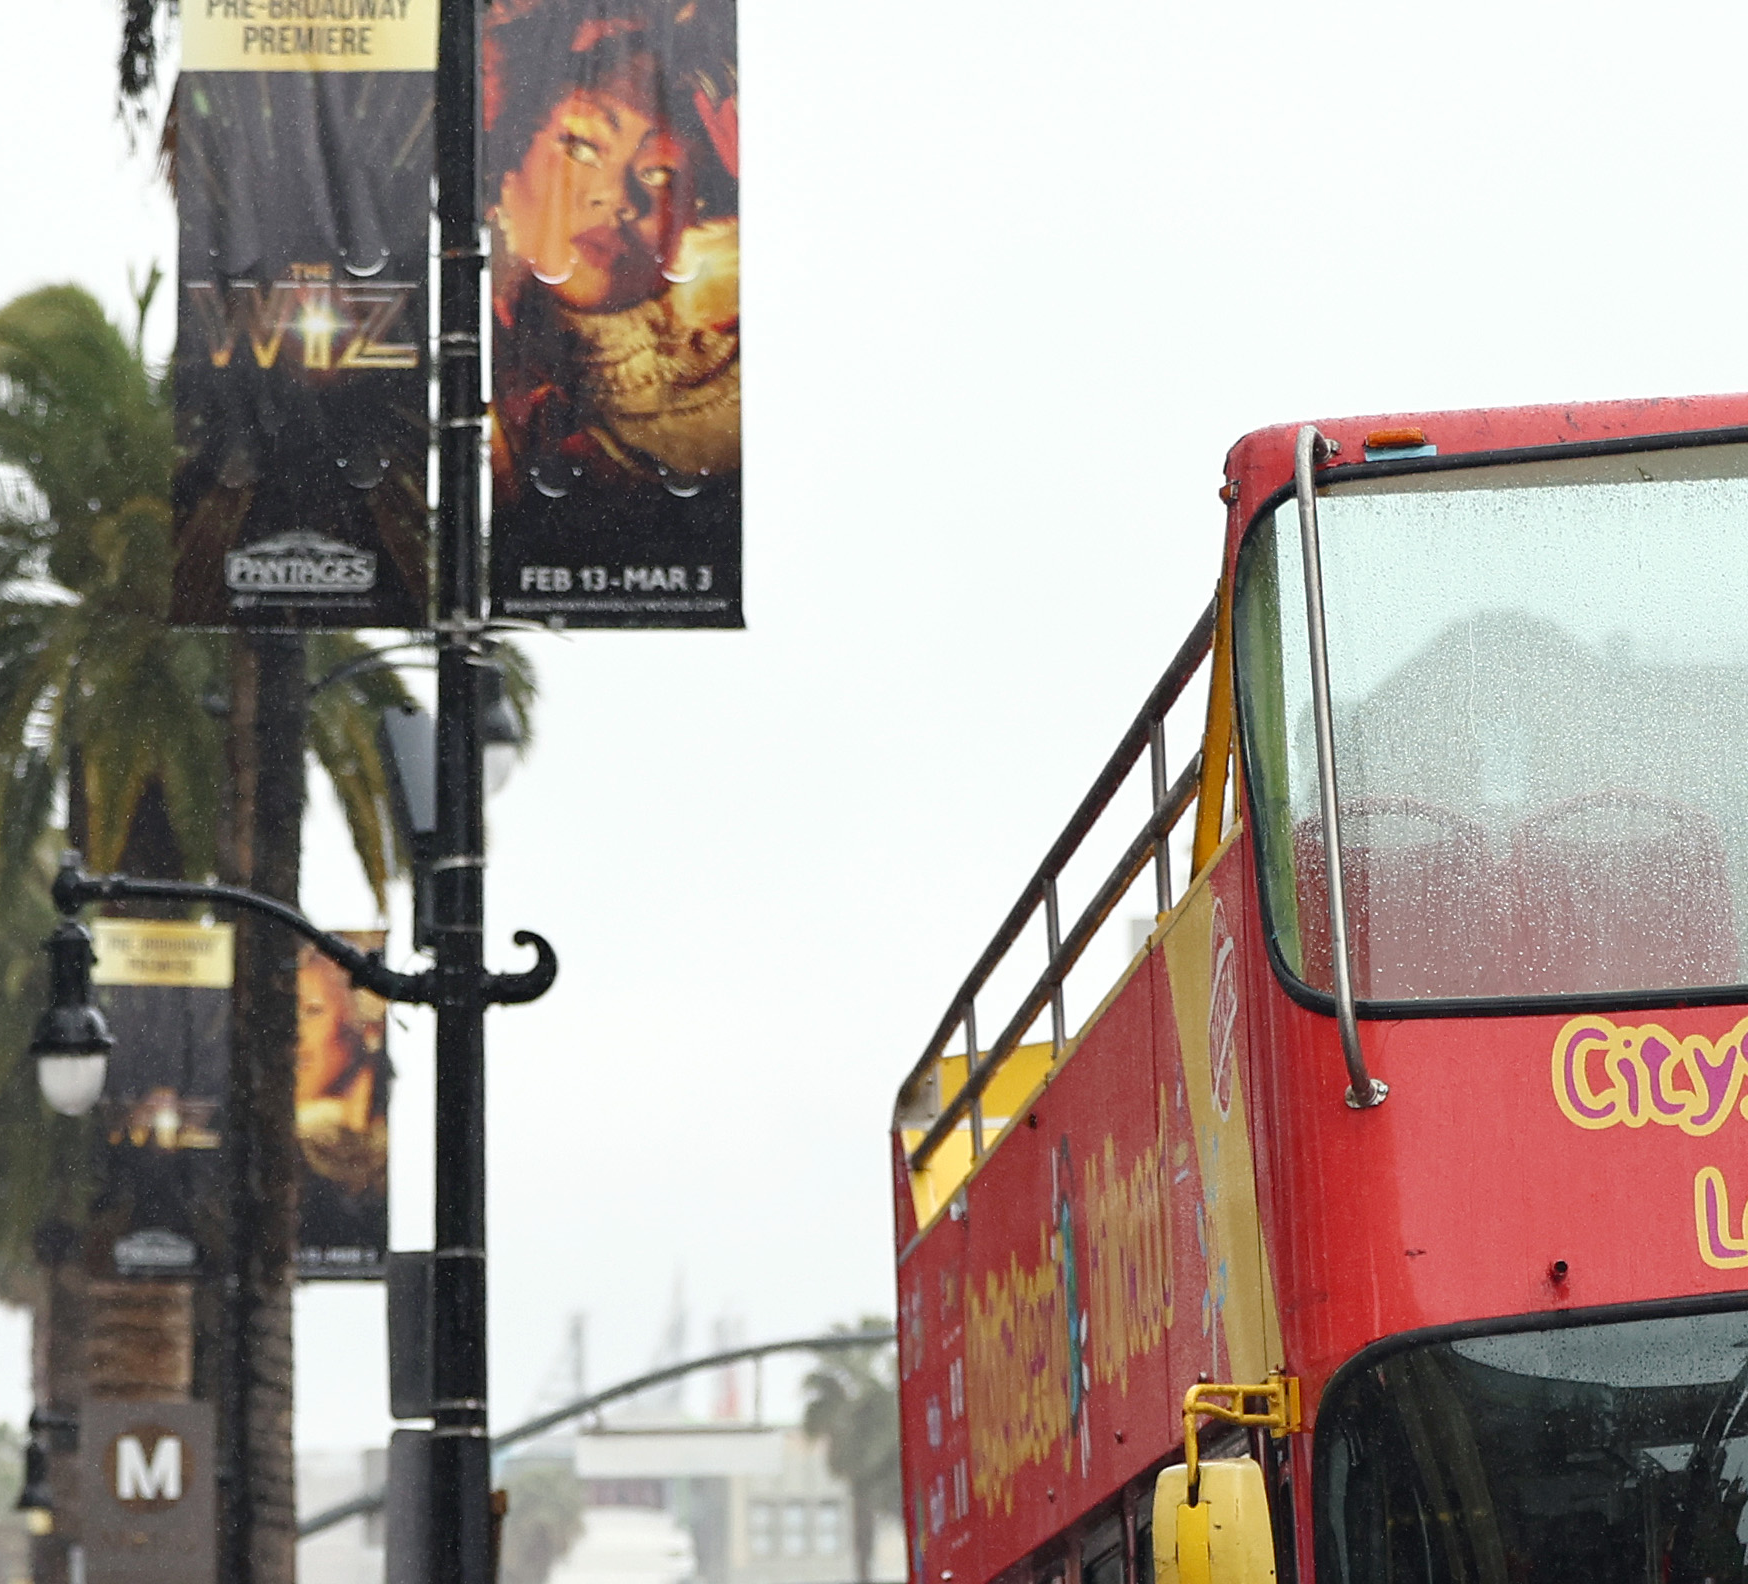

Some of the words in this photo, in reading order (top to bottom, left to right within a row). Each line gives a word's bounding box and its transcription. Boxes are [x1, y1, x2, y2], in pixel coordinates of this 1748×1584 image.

[242, 26, 374, 55] PREMIERE
[185, 280, 420, 370] WIZ
[229, 556, 370, 586] PANTAGES
[520, 566, 574, 592] FEB
[696, 565, 714, 592] 3
[116, 1435, 183, 1501] M
